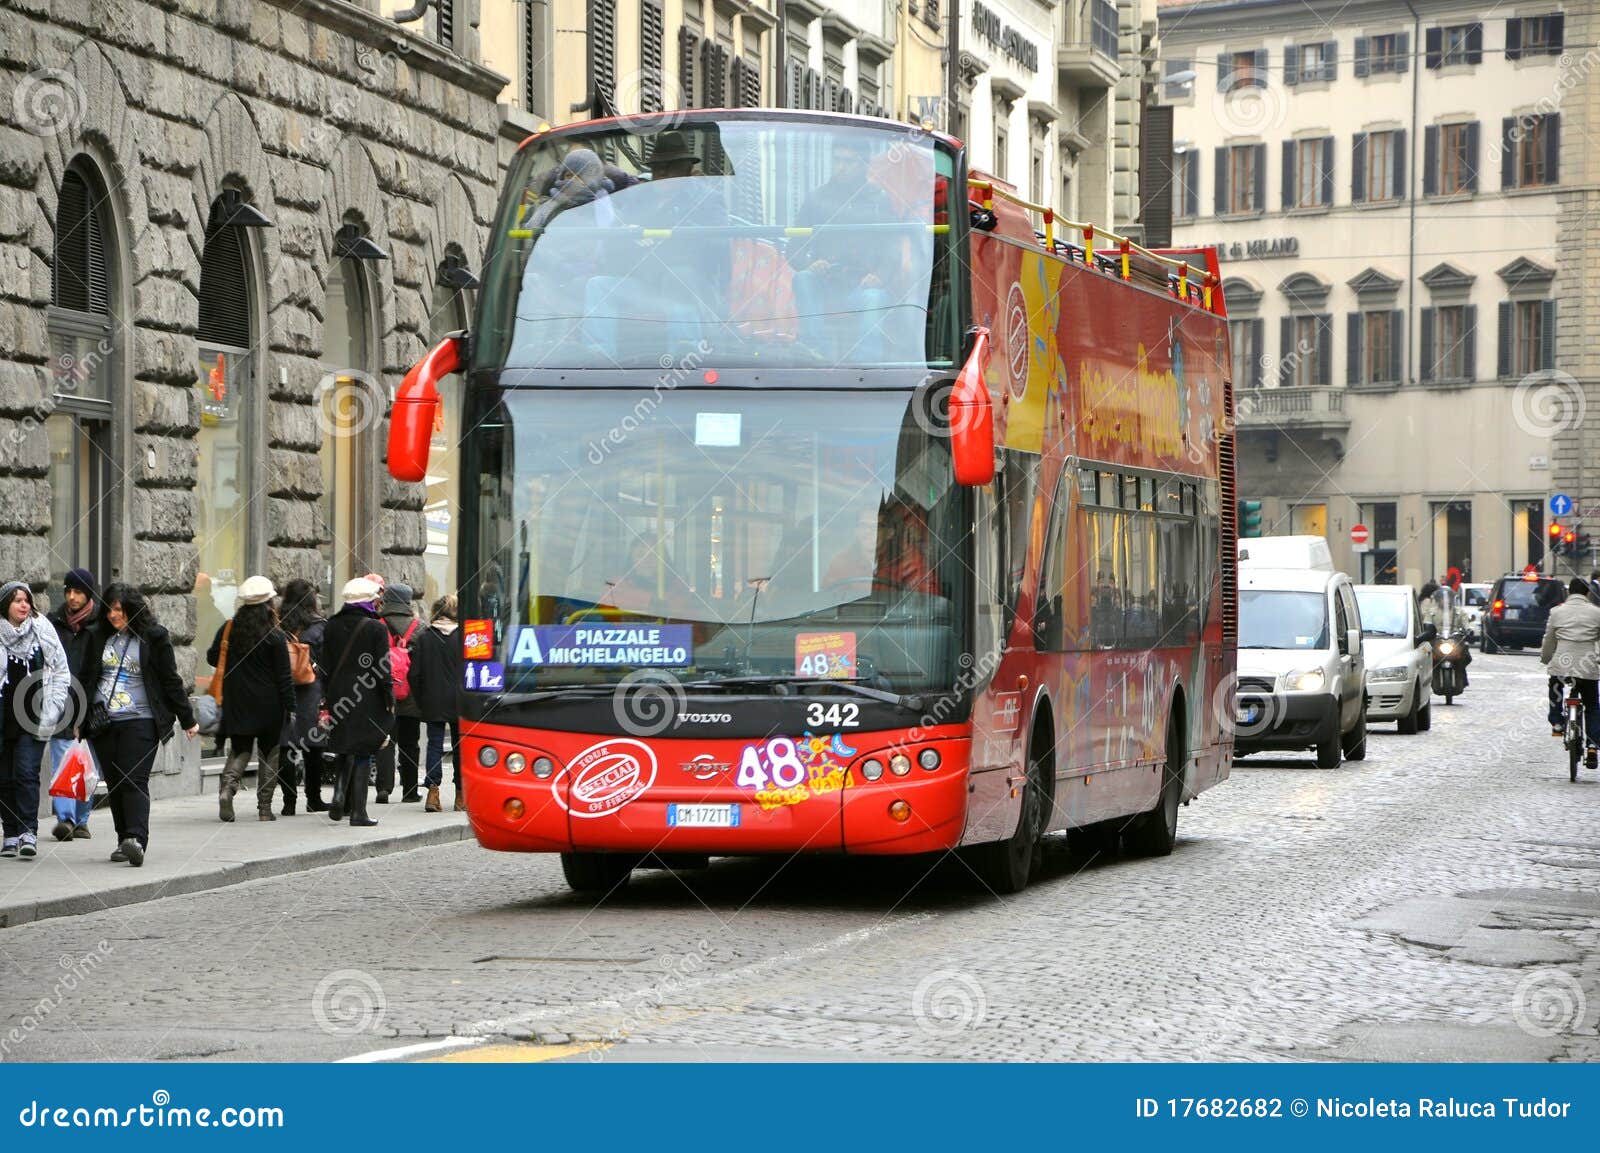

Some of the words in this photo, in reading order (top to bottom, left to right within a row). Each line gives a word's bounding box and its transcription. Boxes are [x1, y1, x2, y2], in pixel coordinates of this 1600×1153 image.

[1247, 237, 1300, 255] MILANO
[512, 628, 543, 664] A
[575, 629, 660, 645] PIAZZALE
[549, 647, 687, 664] MICHELANGELO
[800, 653, 829, 675] 48
[677, 713, 732, 723] VOLVO
[806, 702, 860, 727] 342
[578, 747, 610, 768] TOUR
